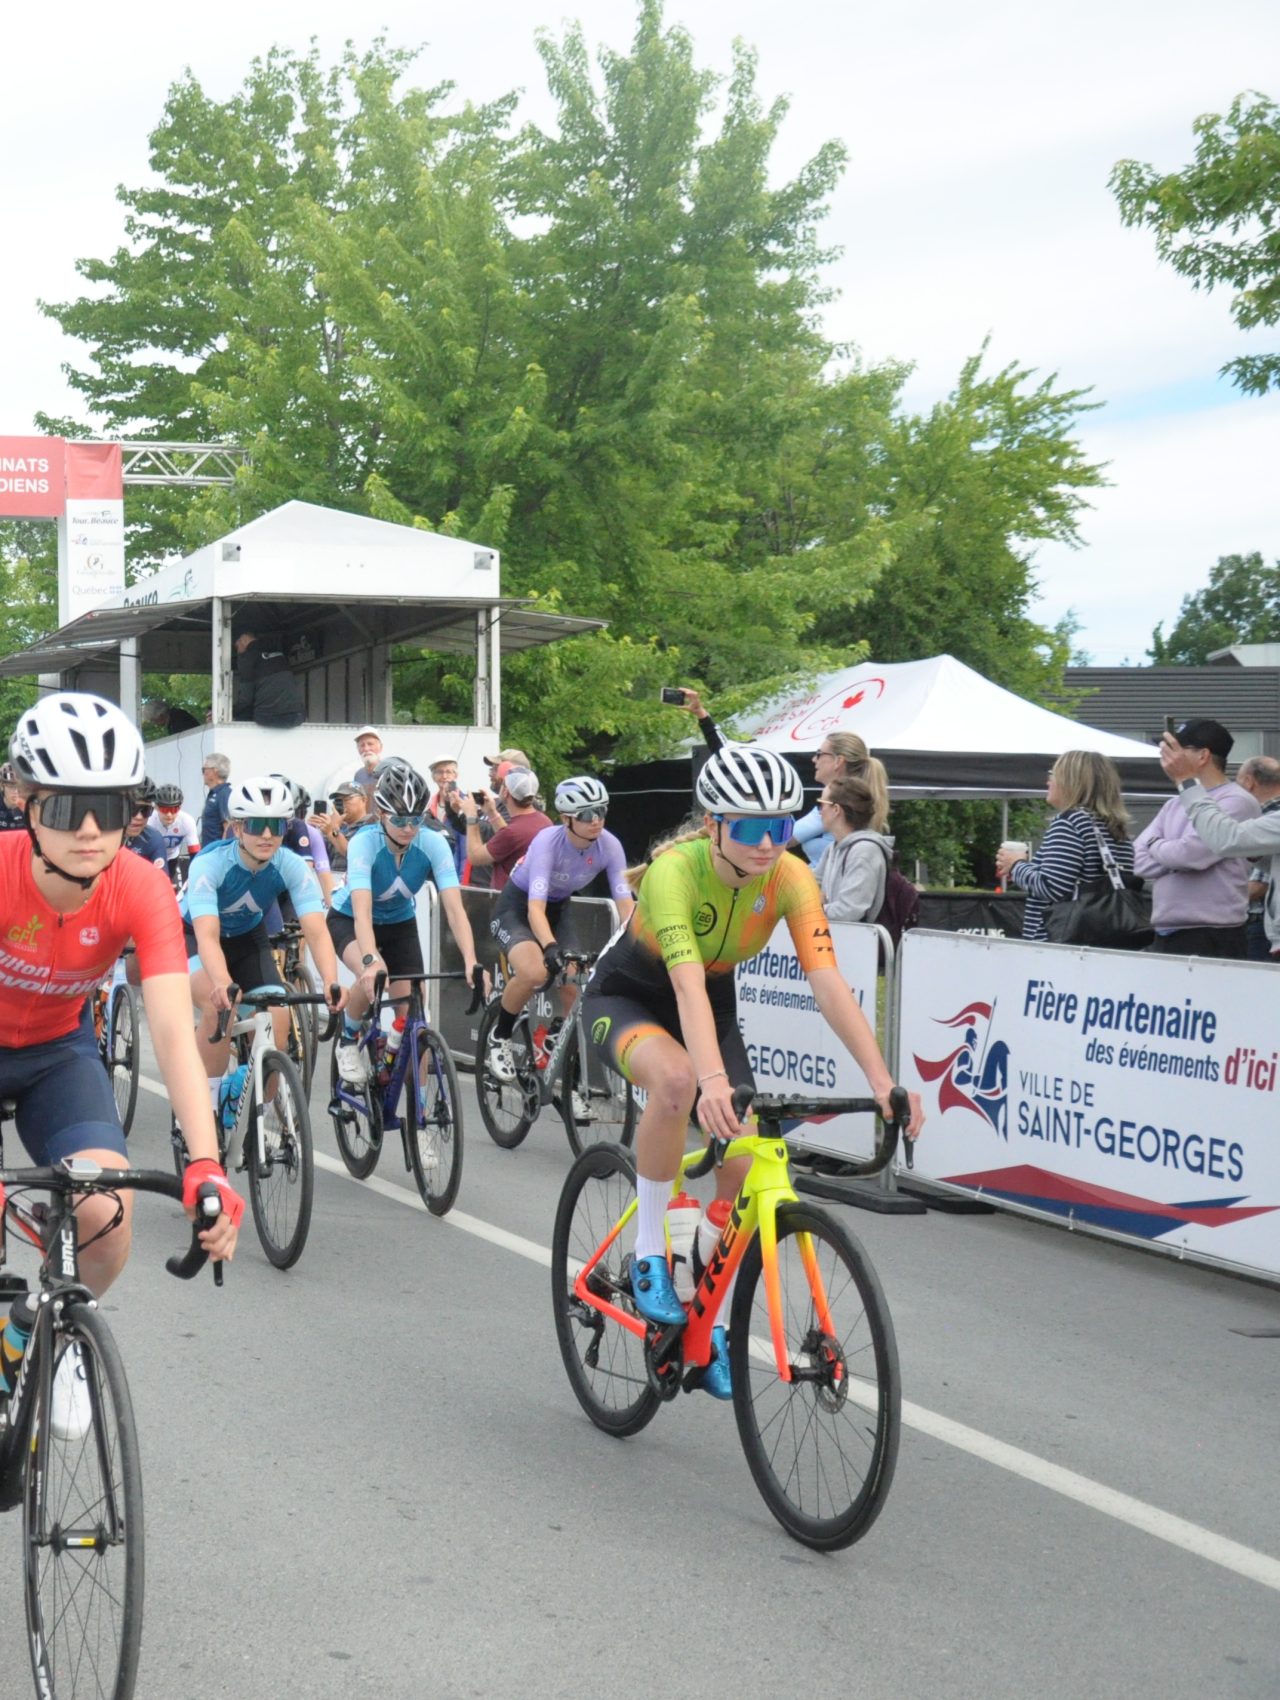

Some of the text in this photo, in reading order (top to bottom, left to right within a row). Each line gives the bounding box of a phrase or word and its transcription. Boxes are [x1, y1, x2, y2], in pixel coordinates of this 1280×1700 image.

[1023, 979, 1217, 1044] Fière partenaire
[746, 1043, 837, 1089] GEORGES
[1085, 1038, 1114, 1065] des
[1118, 1041, 1220, 1082] événements
[1019, 1070, 1095, 1107] VILLE DE
[1018, 1100, 1244, 1183] SAINT-GEORGES
[61, 1229, 75, 1277] BMC
[692, 1183, 752, 1320] TREK
